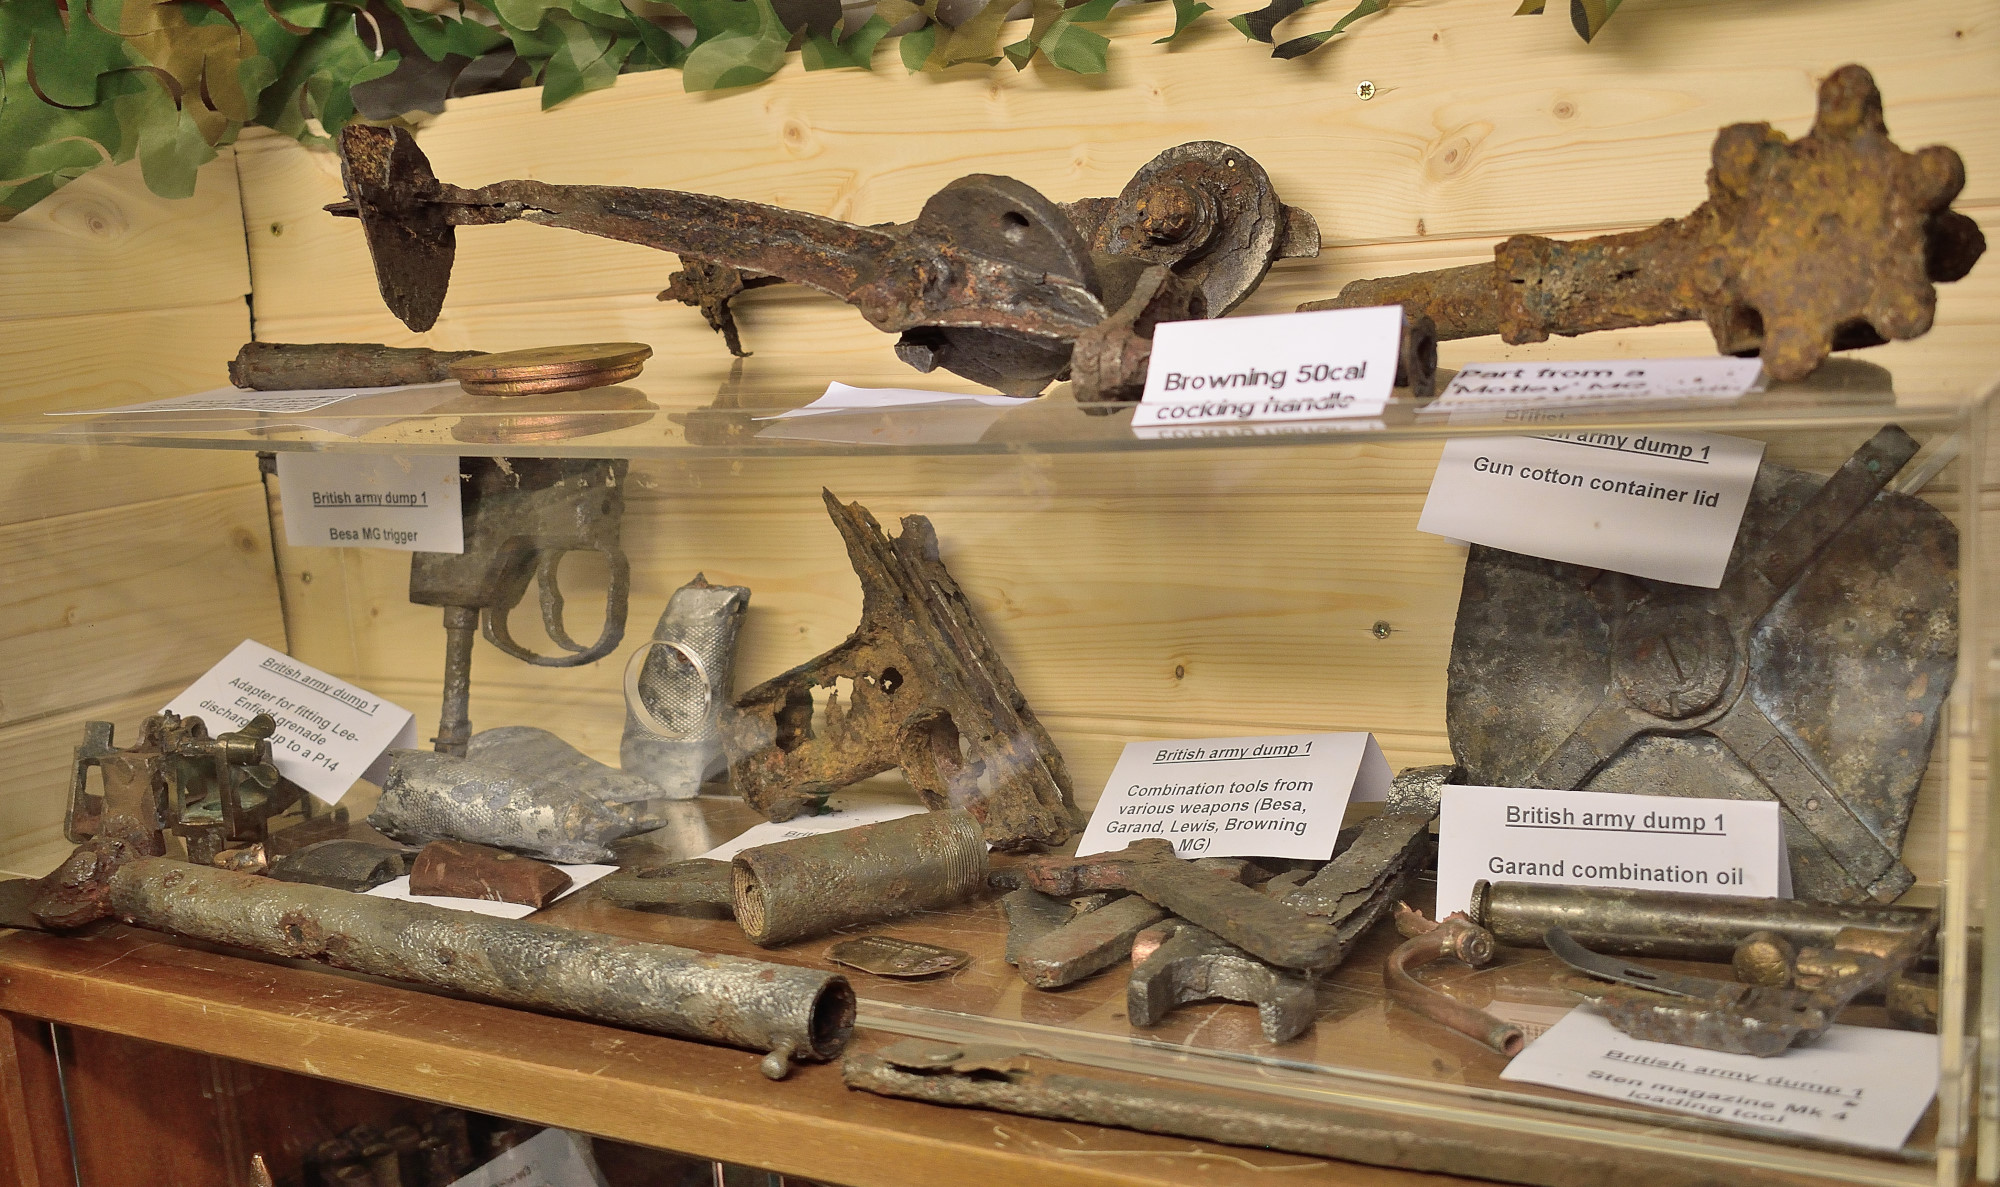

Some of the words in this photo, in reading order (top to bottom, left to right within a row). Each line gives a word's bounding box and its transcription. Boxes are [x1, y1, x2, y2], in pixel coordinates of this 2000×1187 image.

[1163, 367, 1288, 392] Browning
[1295, 360, 1368, 383] 50cal
[1458, 367, 1524, 380] Part
[1537, 367, 1614, 379] from
[1624, 369, 1646, 378] a
[1156, 399, 1255, 421] cocking
[1576, 431, 1629, 451] army
[1633, 436, 1693, 460] dump
[1700, 445, 1712, 460] 1
[1472, 455, 1514, 476] Gun
[1519, 466, 1584, 488] cotton
[1589, 474, 1689, 504] container
[1692, 489, 1721, 508] lid
[312, 491, 352, 505] British
[354, 494, 383, 506] army
[385, 491, 418, 506] dump
[421, 491, 429, 504] 1
[329, 527, 359, 541] Besa
[362, 528, 381, 541] MG
[383, 529, 419, 545] trigger
[261, 657, 303, 680] British
[301, 674, 334, 694] army
[333, 687, 369, 711] dump
[371, 703, 382, 714] 1
[228, 677, 279, 703] Adapter
[277, 696, 296, 711] for
[294, 704, 332, 731] fitting
[331, 722, 360, 744] Lee-
[234, 696, 279, 717] Enfield
[275, 716, 327, 746] grenade
[199, 699, 250, 729] discharg
[269, 733, 287, 745] up
[286, 738, 302, 753] to
[301, 749, 310, 759] a
[312, 752, 341, 772] P14
[1153, 747, 1206, 763] British
[1208, 747, 1250, 762] army
[1252, 742, 1299, 759] dump
[1304, 741, 1314, 755] 1
[1126, 782, 1226, 798] Combination
[1229, 779, 1269, 795] tools
[1273, 778, 1314, 793] from
[1118, 800, 1175, 816] various
[1179, 801, 1250, 817] weapons
[1253, 797, 1308, 815] (Besa,
[1505, 804, 1575, 827] British
[1581, 812, 1636, 831] army
[1643, 810, 1707, 835] dump
[1713, 813, 1725, 832] 1
[1105, 819, 1165, 836] Garand,
[1169, 819, 1221, 835] Lewis,
[1224, 818, 1308, 836] Browning
[1177, 837, 1212, 853] MG)
[1488, 856, 1566, 878] Garand
[1571, 861, 1709, 885] combination
[1716, 867, 1745, 886] oil
[1603, 1049, 1686, 1071] British
[1694, 1064, 1760, 1082] army
[1765, 1075, 1842, 1095] dump
[1852, 1087, 1865, 1099] 1
[1587, 1069, 1643, 1087] Sten
[1650, 1083, 1776, 1110] magazine
[1784, 1104, 1824, 1118] Mk
[1831, 1111, 1848, 1121] 4
[1627, 1090, 1724, 1115] loading
[1732, 1107, 1787, 1123] tool
